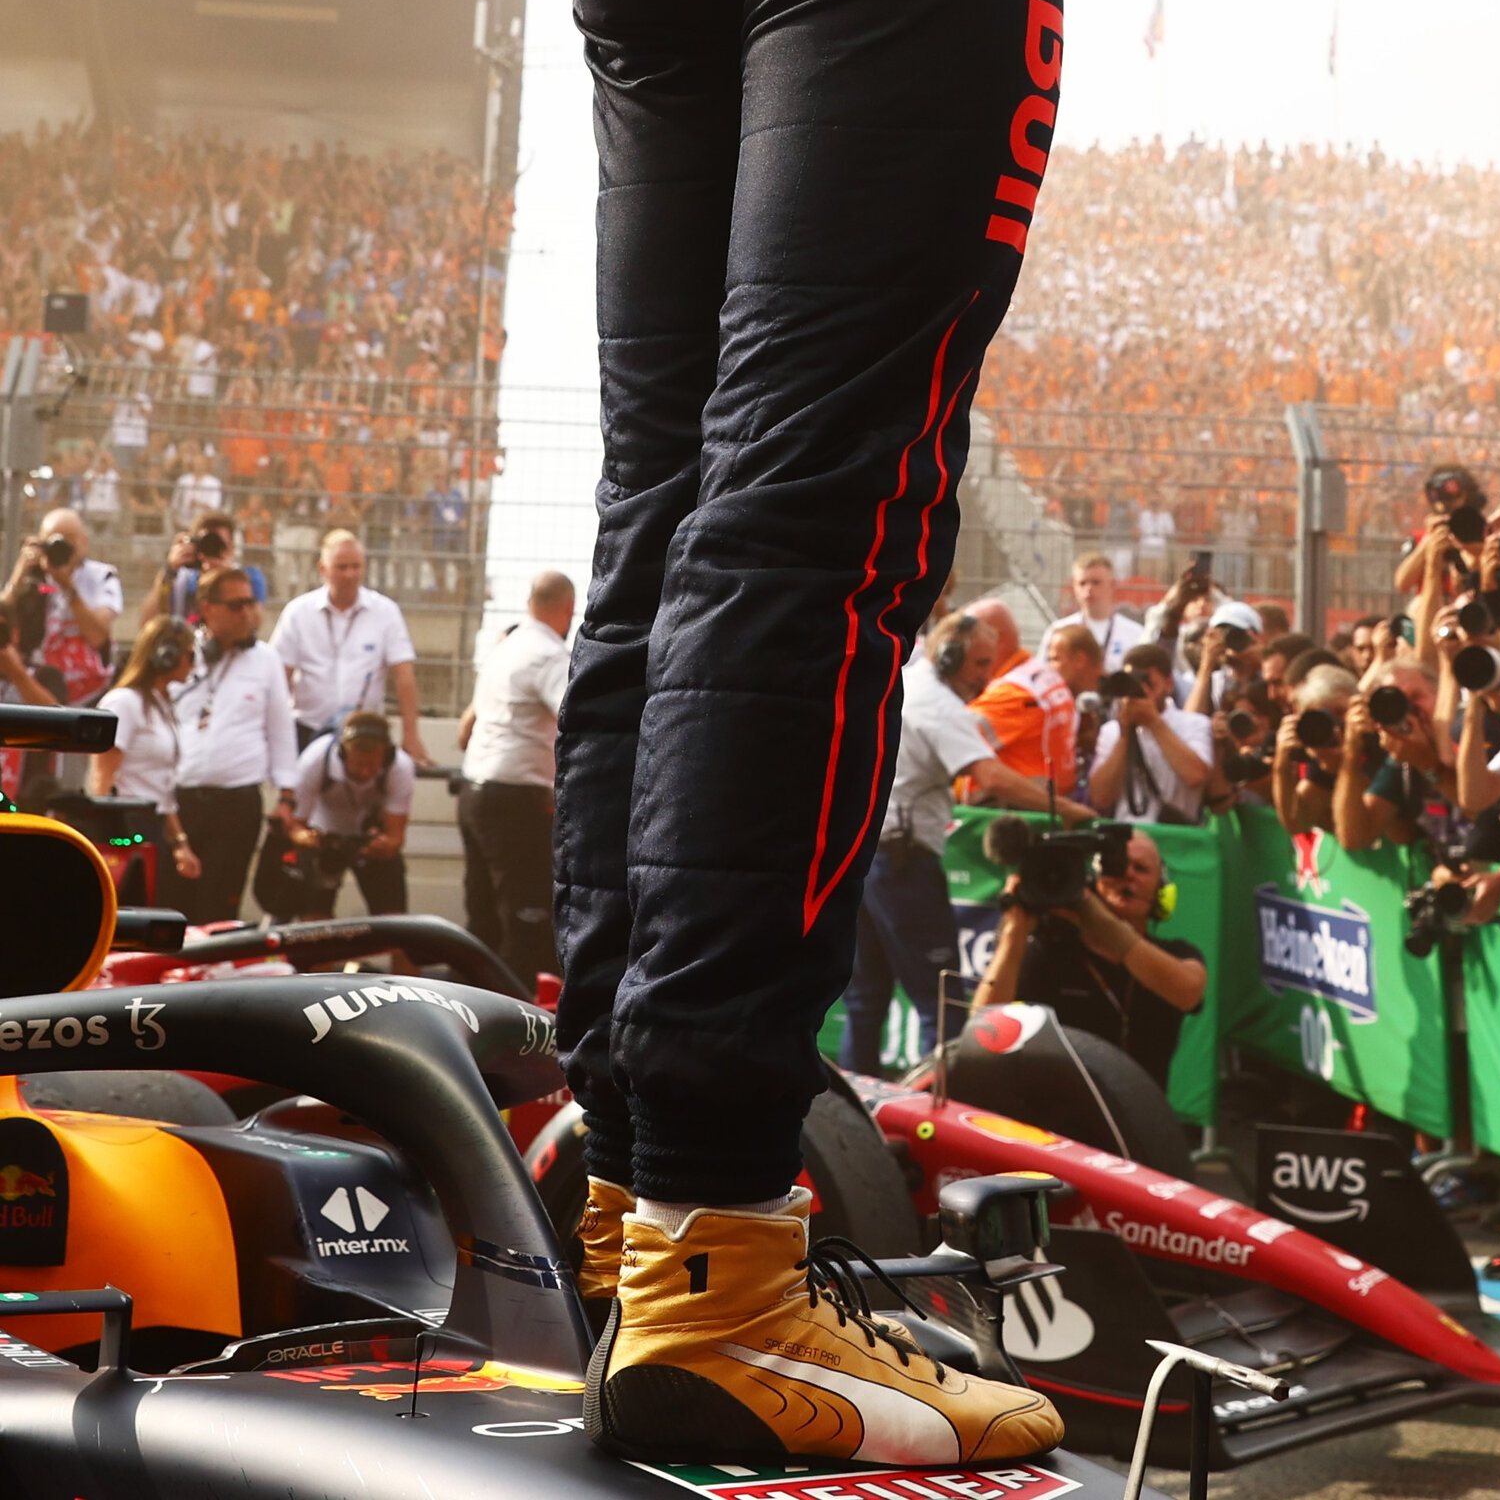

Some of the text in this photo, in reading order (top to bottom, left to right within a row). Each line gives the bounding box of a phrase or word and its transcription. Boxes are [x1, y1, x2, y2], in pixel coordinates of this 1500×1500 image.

[0, 1012, 110, 1051] ezos
[303, 985, 479, 1044] JUMBO
[1272, 1151, 1368, 1196] aws
[316, 1236, 411, 1258] inter.mx
[1106, 1211, 1256, 1266] Santander
[682, 1251, 709, 1295] 1
[267, 1340, 345, 1363] ORACLE
[763, 1338, 842, 1366] SPEEDCAT PRO
